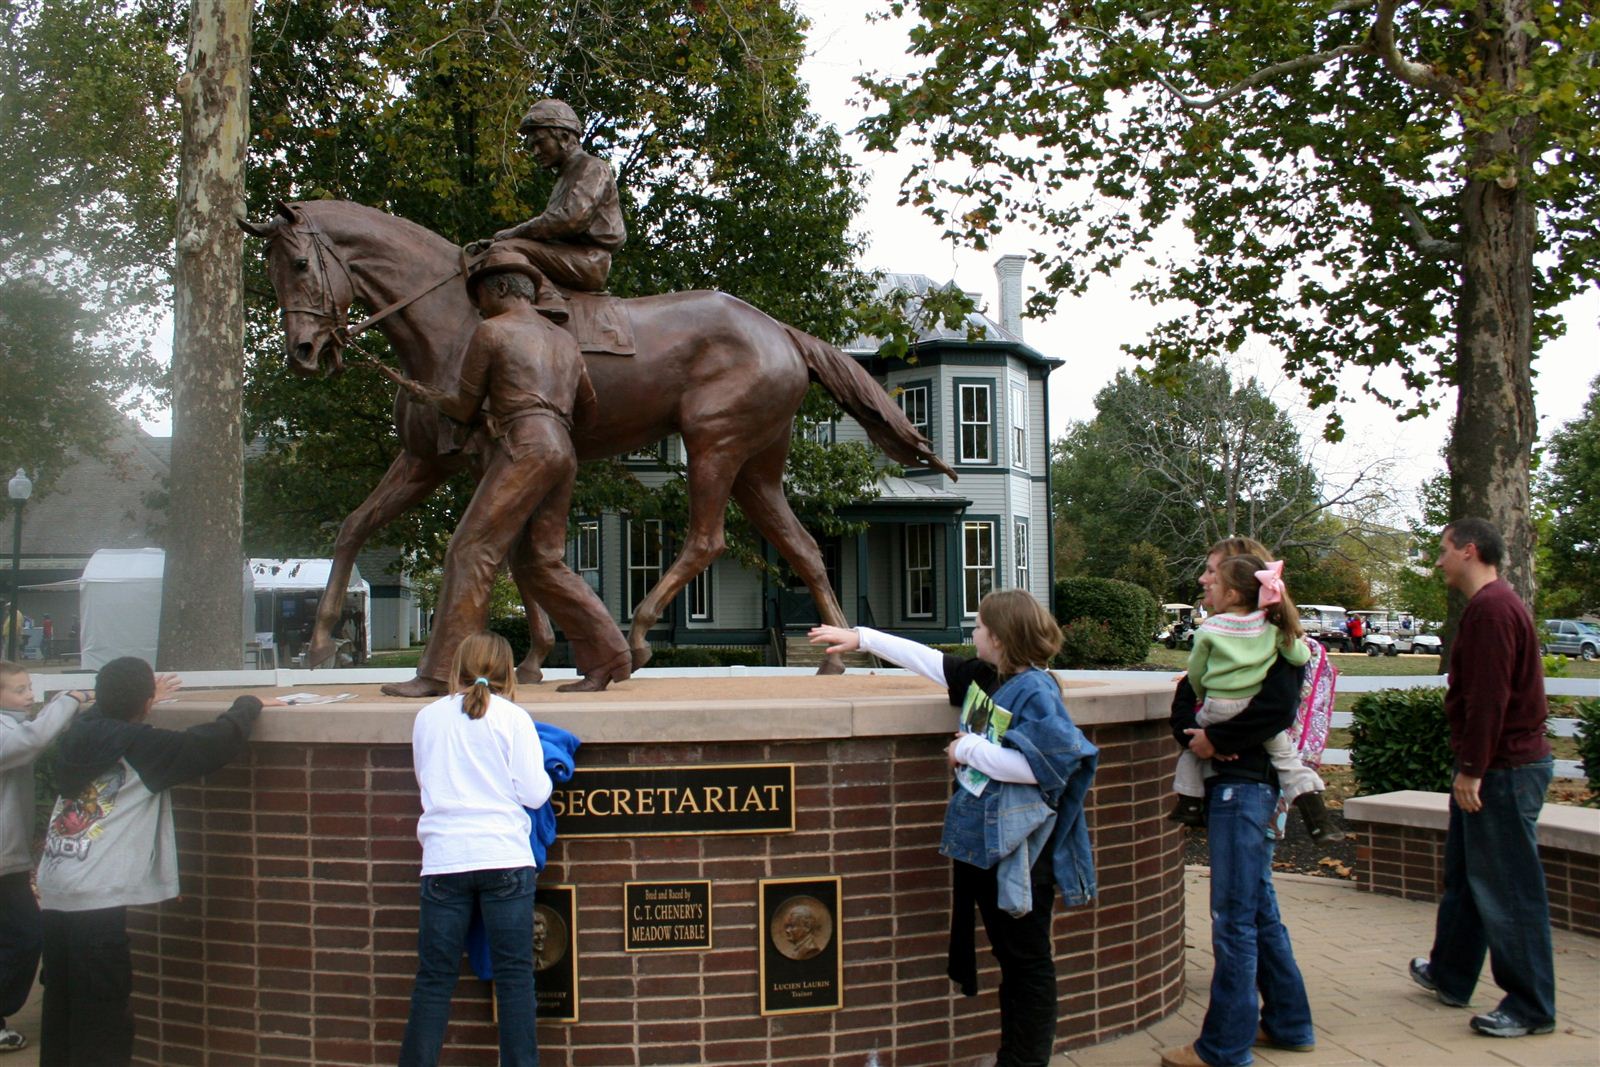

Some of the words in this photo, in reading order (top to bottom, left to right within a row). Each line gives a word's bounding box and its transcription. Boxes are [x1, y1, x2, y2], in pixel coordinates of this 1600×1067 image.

[551, 785, 784, 816] SECRETARIAT
[658, 889, 667, 899] and
[669, 888, 683, 899] Raced
[685, 888, 691, 901] by
[633, 905, 643, 920] C.
[644, 905, 652, 920] T.
[654, 904, 703, 920] CHENERY'S
[632, 925, 672, 941] MEADOW
[674, 924, 705, 940] STABLE
[773, 982, 801, 990] LUCIEN
